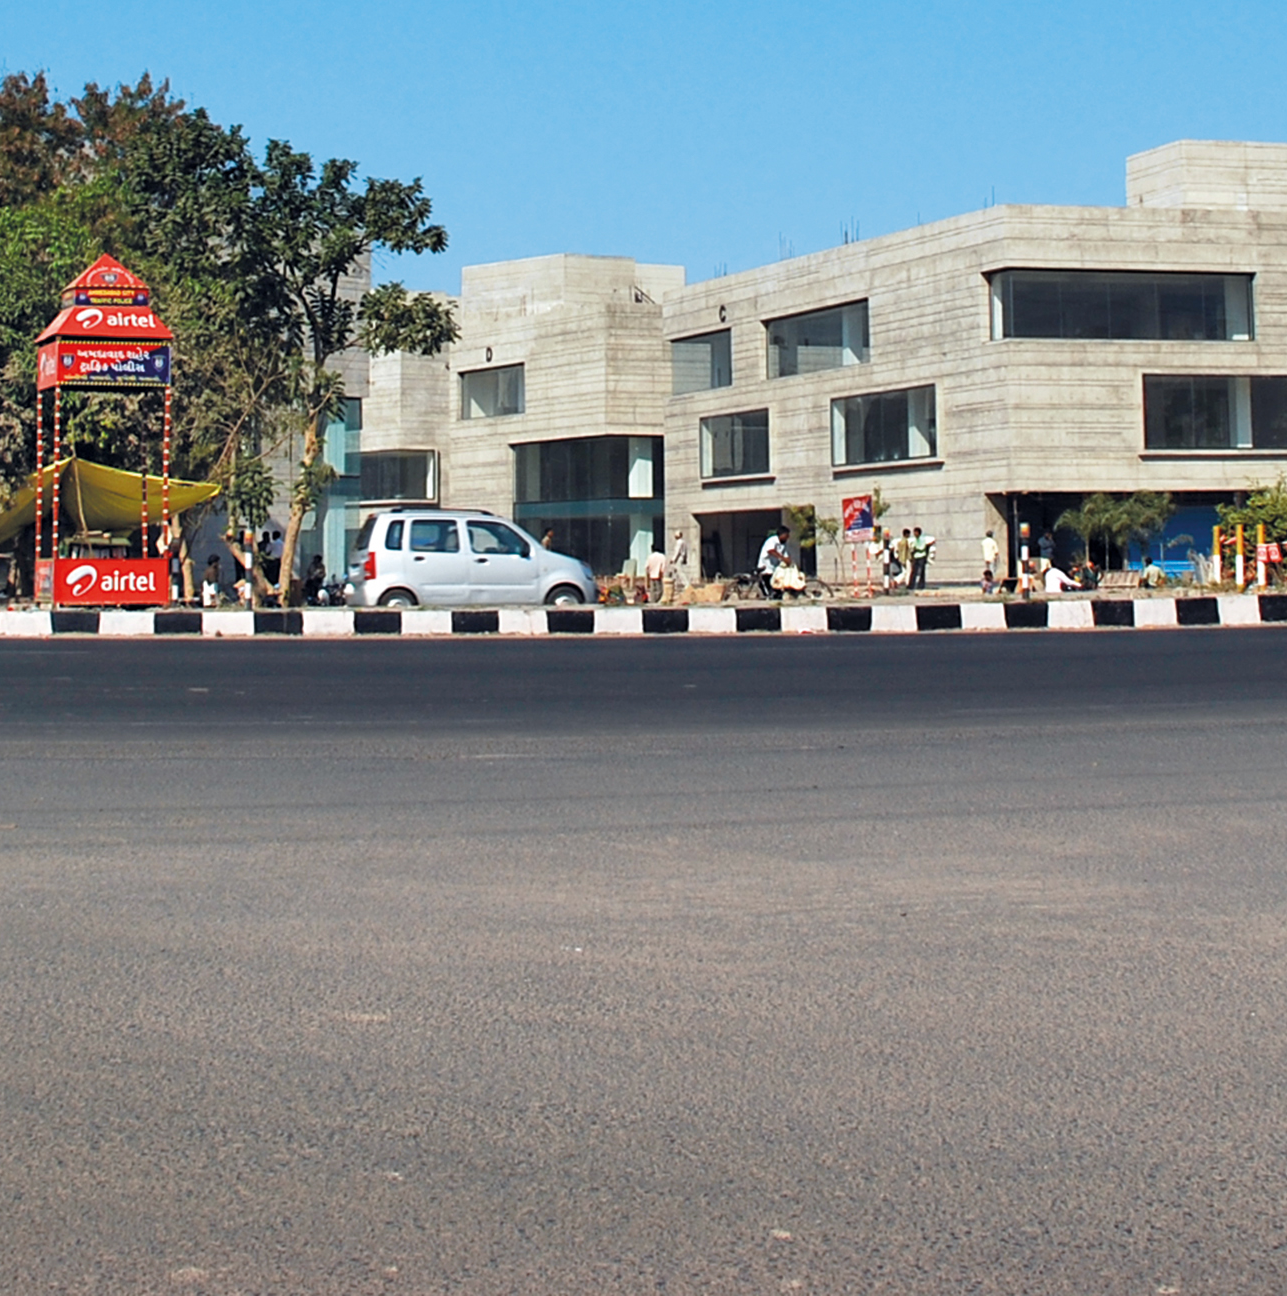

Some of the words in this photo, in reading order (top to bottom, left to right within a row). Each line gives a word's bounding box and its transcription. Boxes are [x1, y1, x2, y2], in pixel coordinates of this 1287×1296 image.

[106, 312, 156, 328] airtel
[719, 304, 727, 323] C
[485, 346, 493, 363] D
[101, 570, 156, 591] airtel
